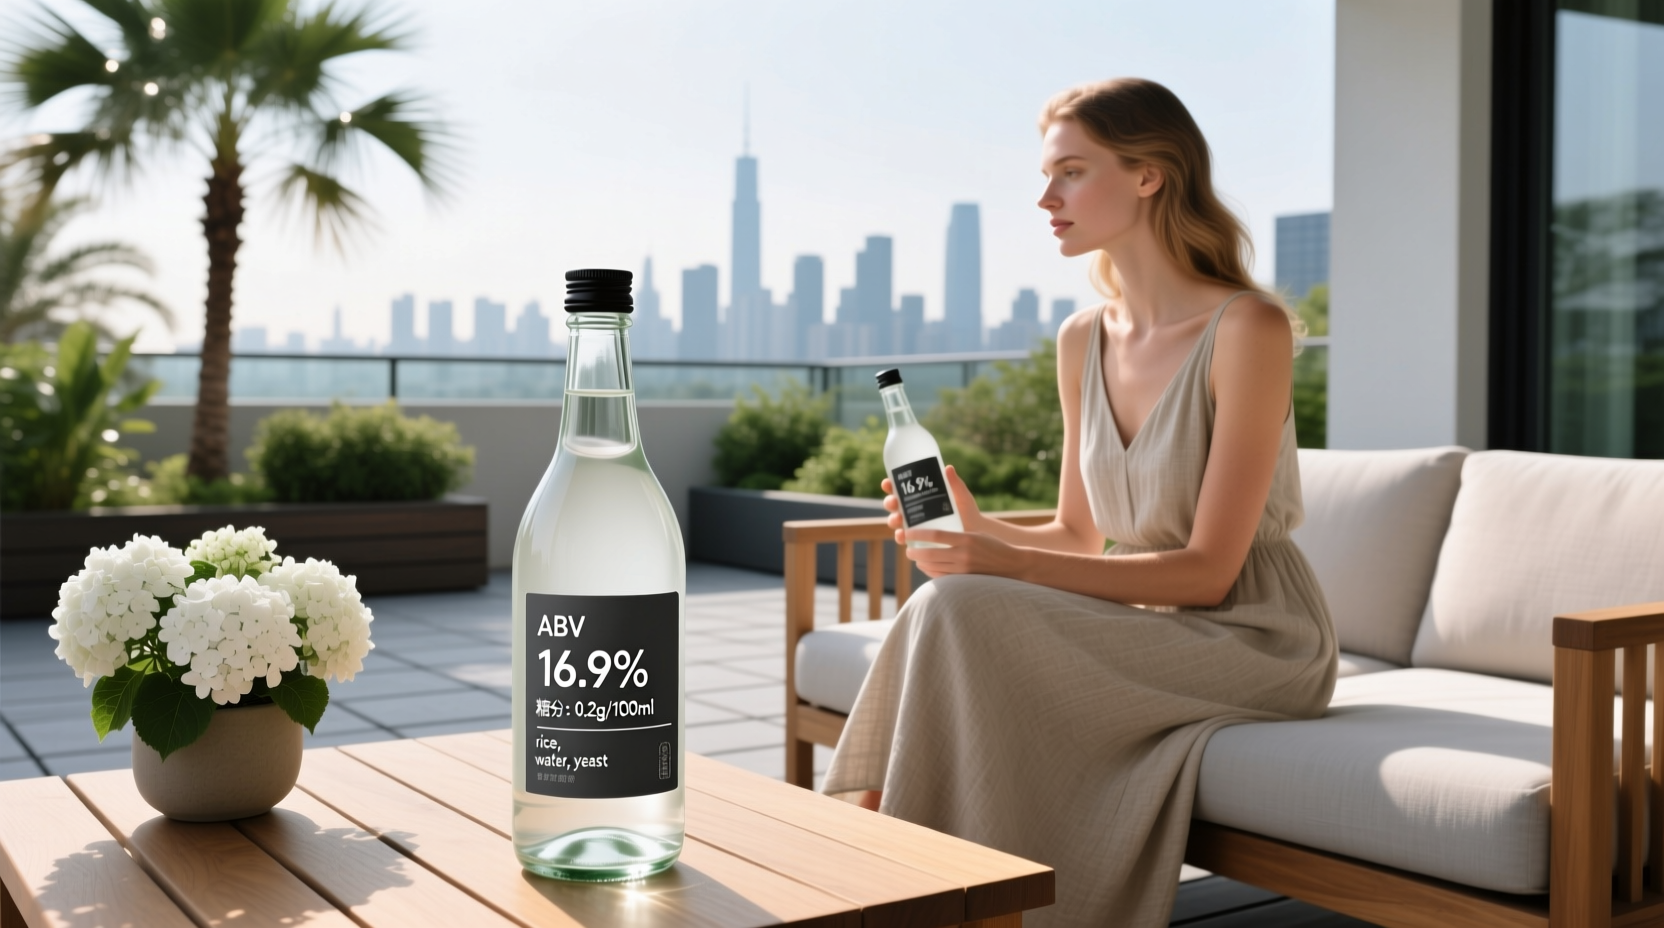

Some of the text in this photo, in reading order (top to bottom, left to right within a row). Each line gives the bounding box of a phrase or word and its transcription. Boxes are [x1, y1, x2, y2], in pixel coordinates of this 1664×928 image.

[537, 614, 586, 638] ABV
[538, 649, 649, 689] 16.9%
[575, 698, 654, 722] 0.2g/100ml
[535, 734, 561, 752] rice,
[535, 754, 608, 771] water, yeast
